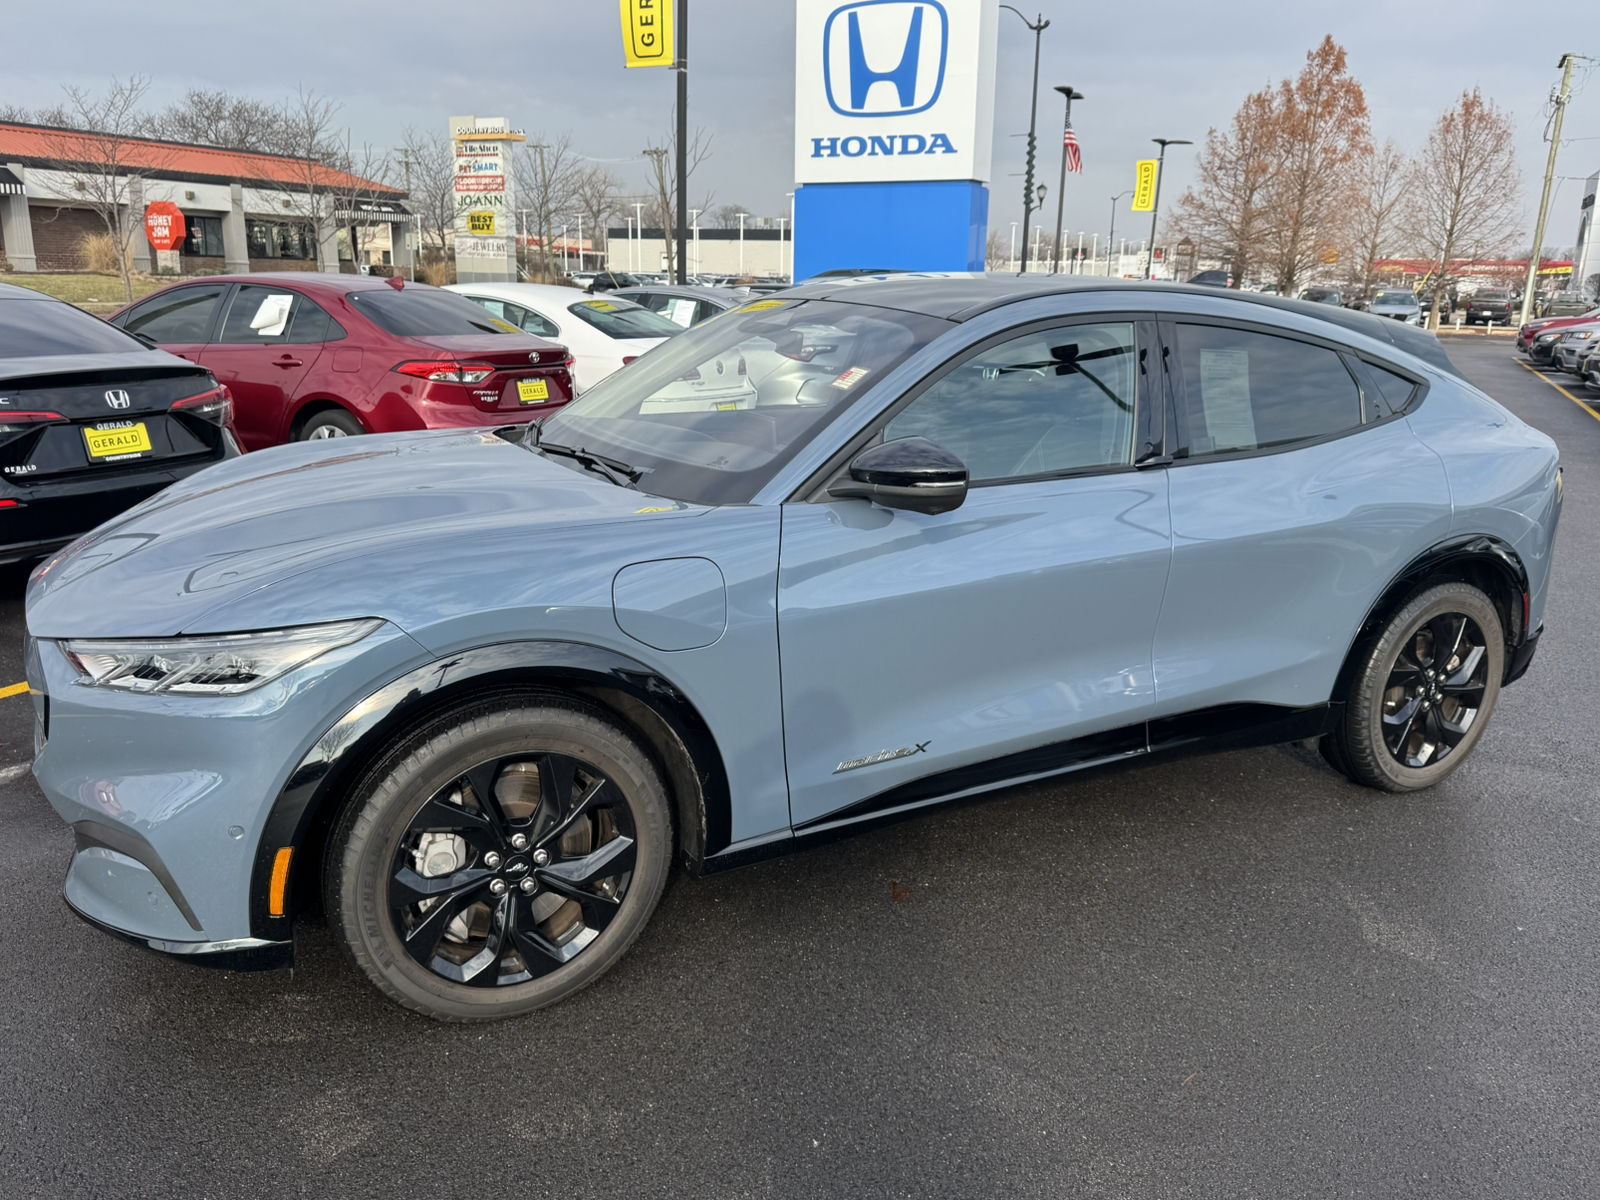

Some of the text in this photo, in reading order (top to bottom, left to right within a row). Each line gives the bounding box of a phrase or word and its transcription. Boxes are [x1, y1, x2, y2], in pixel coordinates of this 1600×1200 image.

[811, 133, 958, 158] HONDA
[1139, 166, 1151, 205] GERALD
[148, 215, 172, 226] HONEY
[470, 215, 494, 223] BEST
[152, 226, 170, 238] JAM
[523, 387, 544, 395] GERALD
[96, 420, 134, 431] GERALD
[94, 435, 138, 448] GERALD
[4, 464, 37, 474] GERALD
